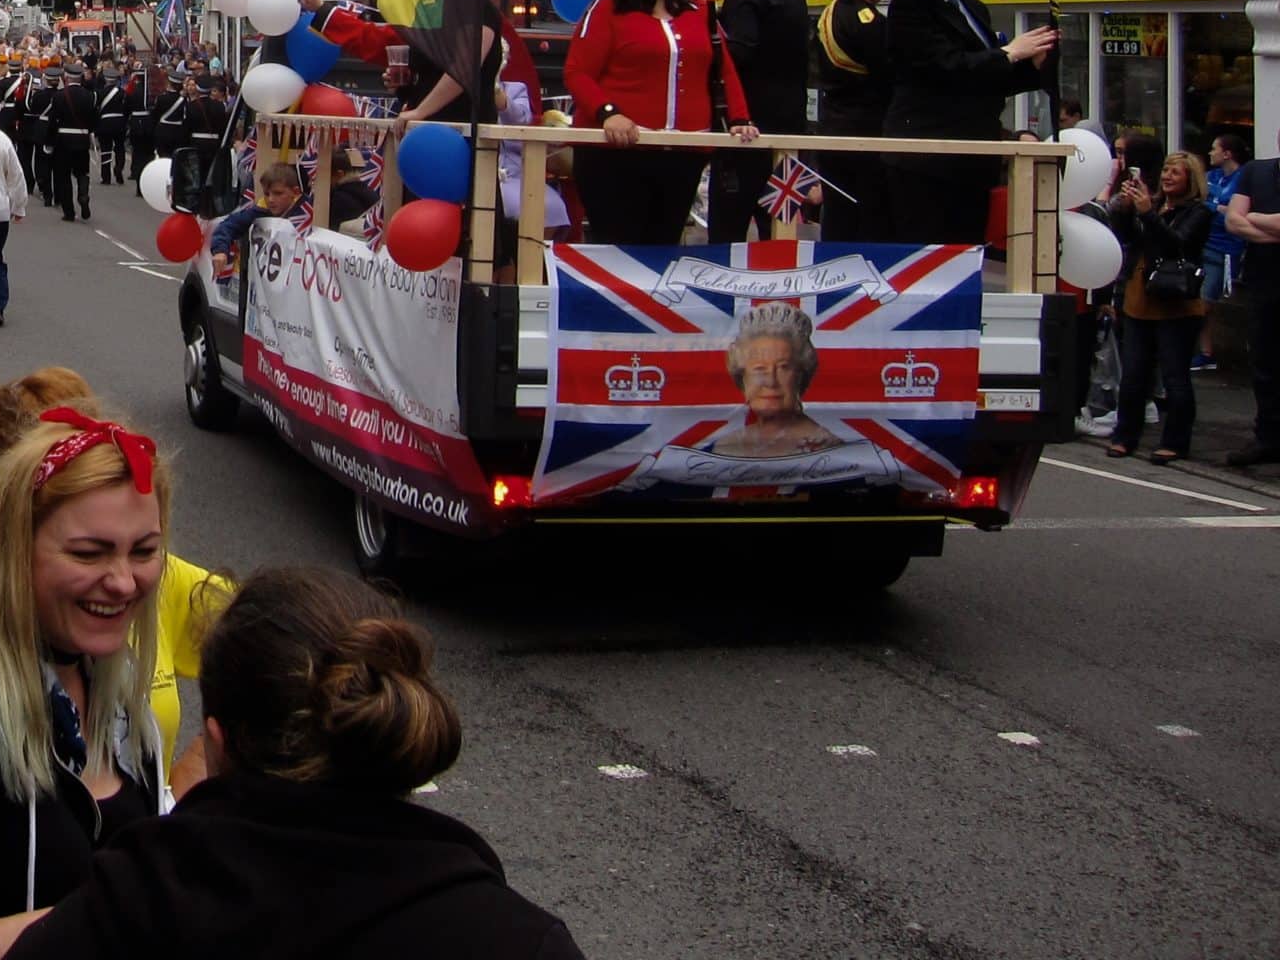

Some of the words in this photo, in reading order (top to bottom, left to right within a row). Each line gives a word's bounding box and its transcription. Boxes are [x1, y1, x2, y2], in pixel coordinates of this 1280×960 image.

[1105, 41, 1139, 54] £1.99
[690, 263, 778, 296] Celebrating
[783, 275, 802, 293] 90
[808, 269, 847, 291] Years
[349, 407, 380, 437] until
[380, 417, 406, 445] you
